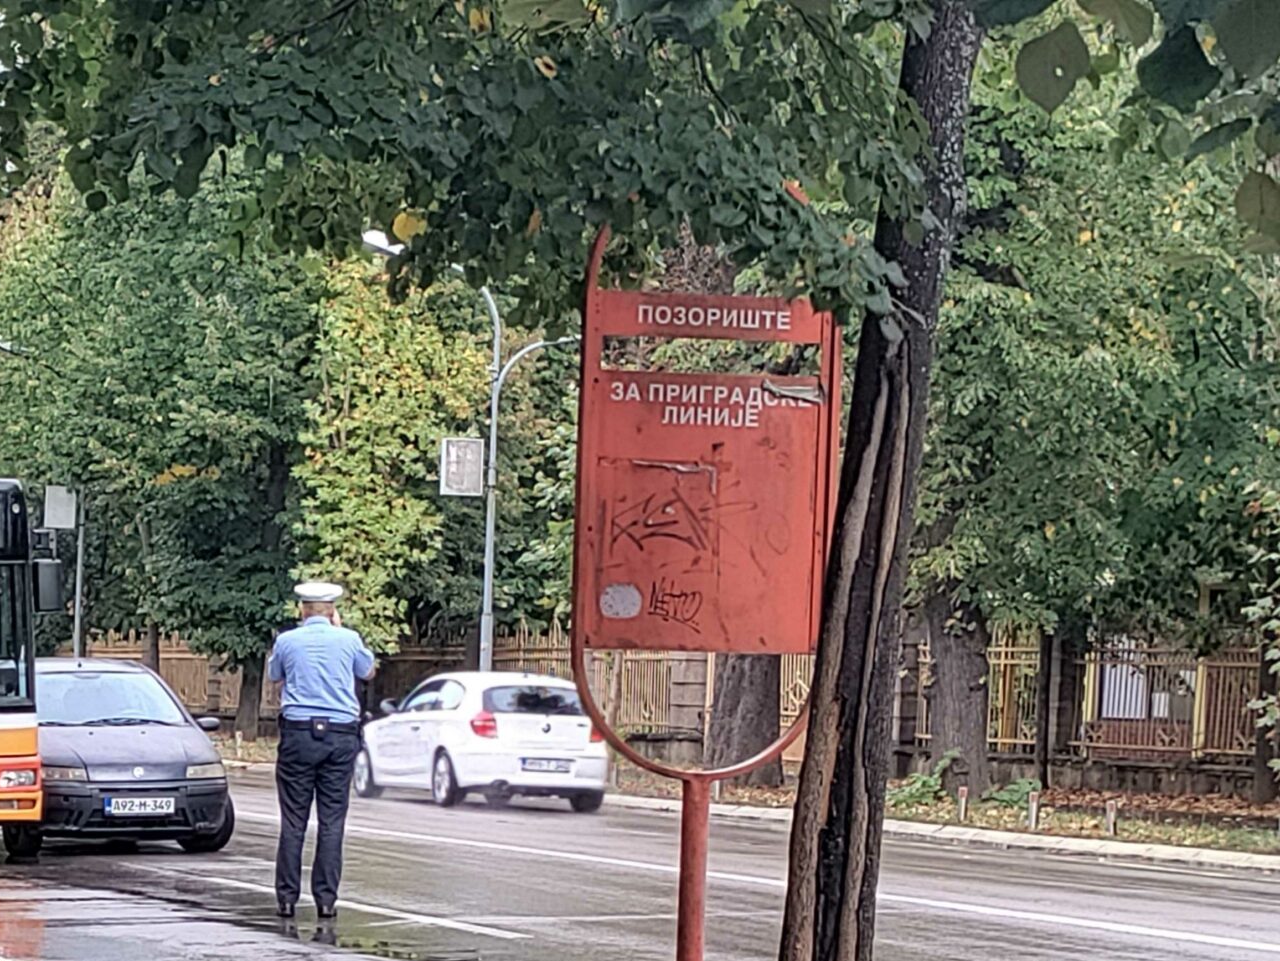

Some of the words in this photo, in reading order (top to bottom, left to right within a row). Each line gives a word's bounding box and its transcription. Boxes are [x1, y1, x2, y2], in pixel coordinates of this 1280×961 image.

[637, 305, 791, 330] ПОЗОРИШТЕ
[610, 382, 641, 401] ЗА
[662, 406, 759, 428] ЛИНИЈЕ
[113, 799, 172, 812] A92-M-349
